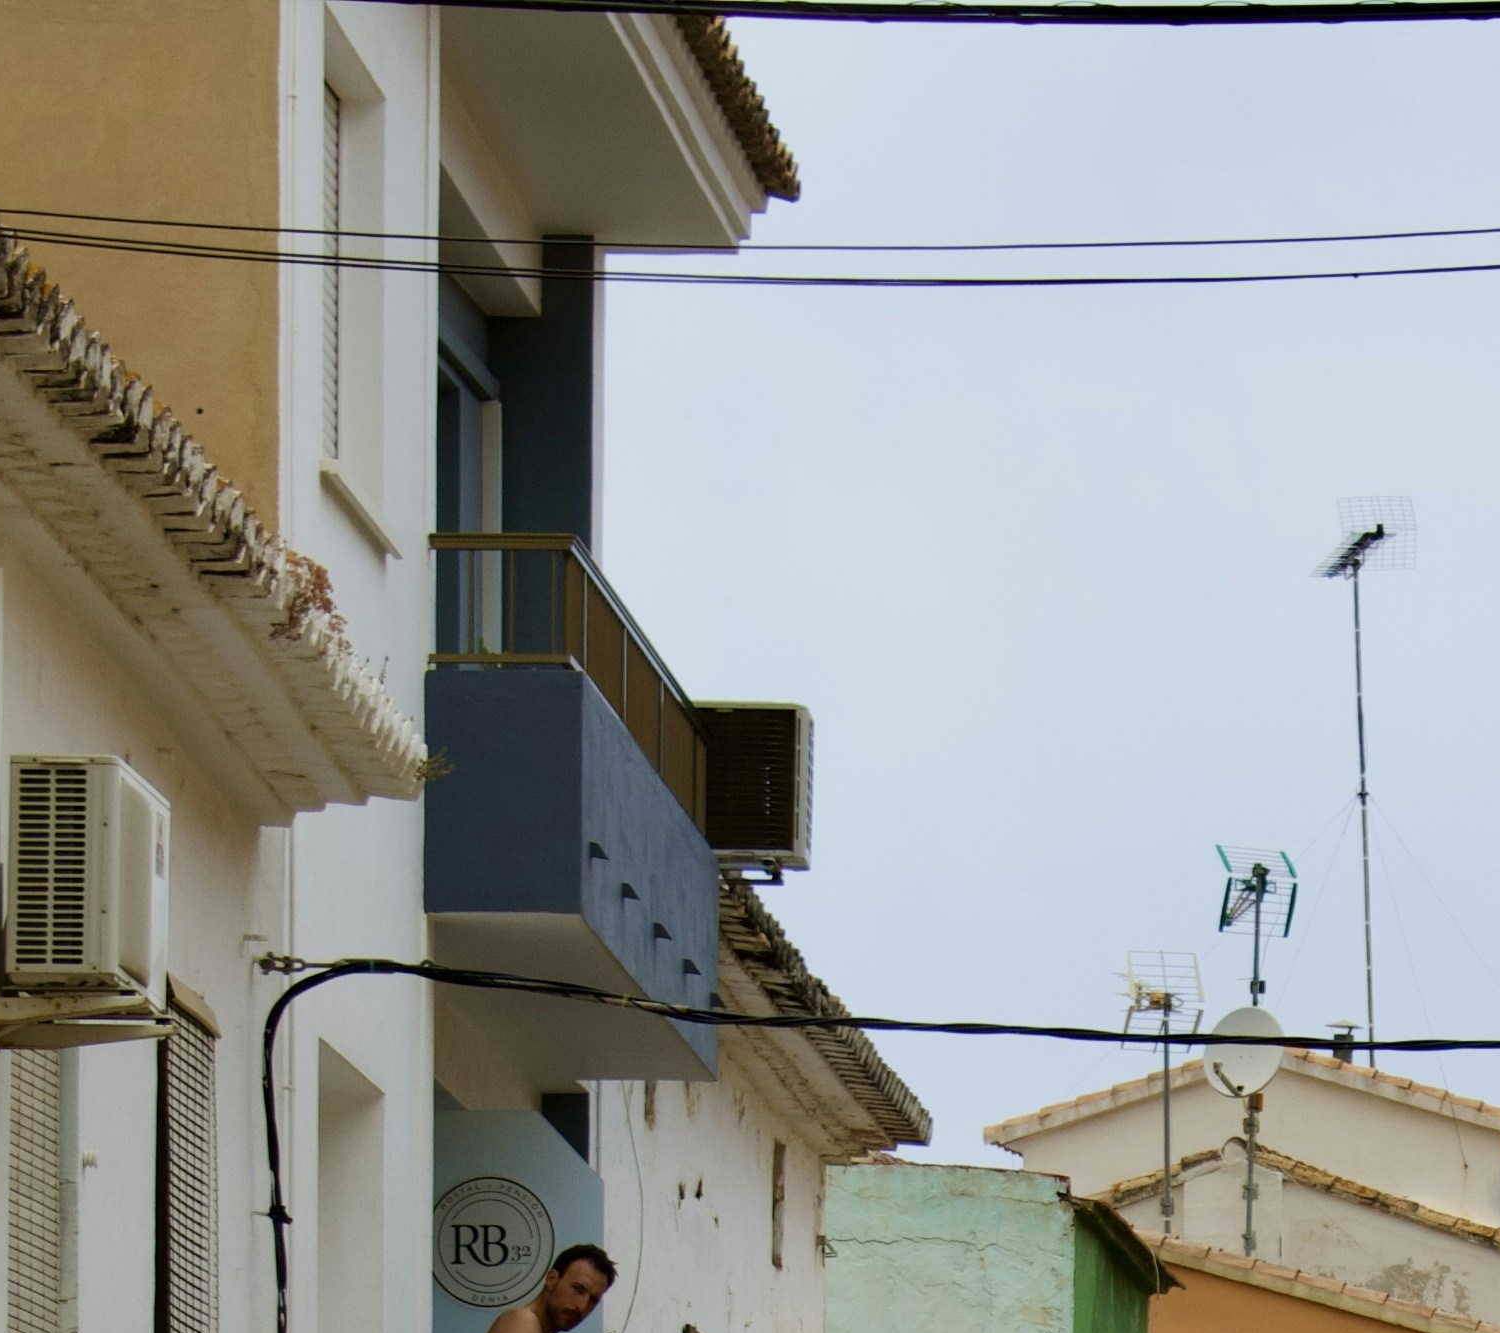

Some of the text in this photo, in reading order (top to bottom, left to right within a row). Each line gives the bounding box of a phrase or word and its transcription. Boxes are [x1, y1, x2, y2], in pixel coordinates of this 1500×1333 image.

[440, 1184, 481, 1211] HOSTAL
[450, 1224, 532, 1267] RB 32
